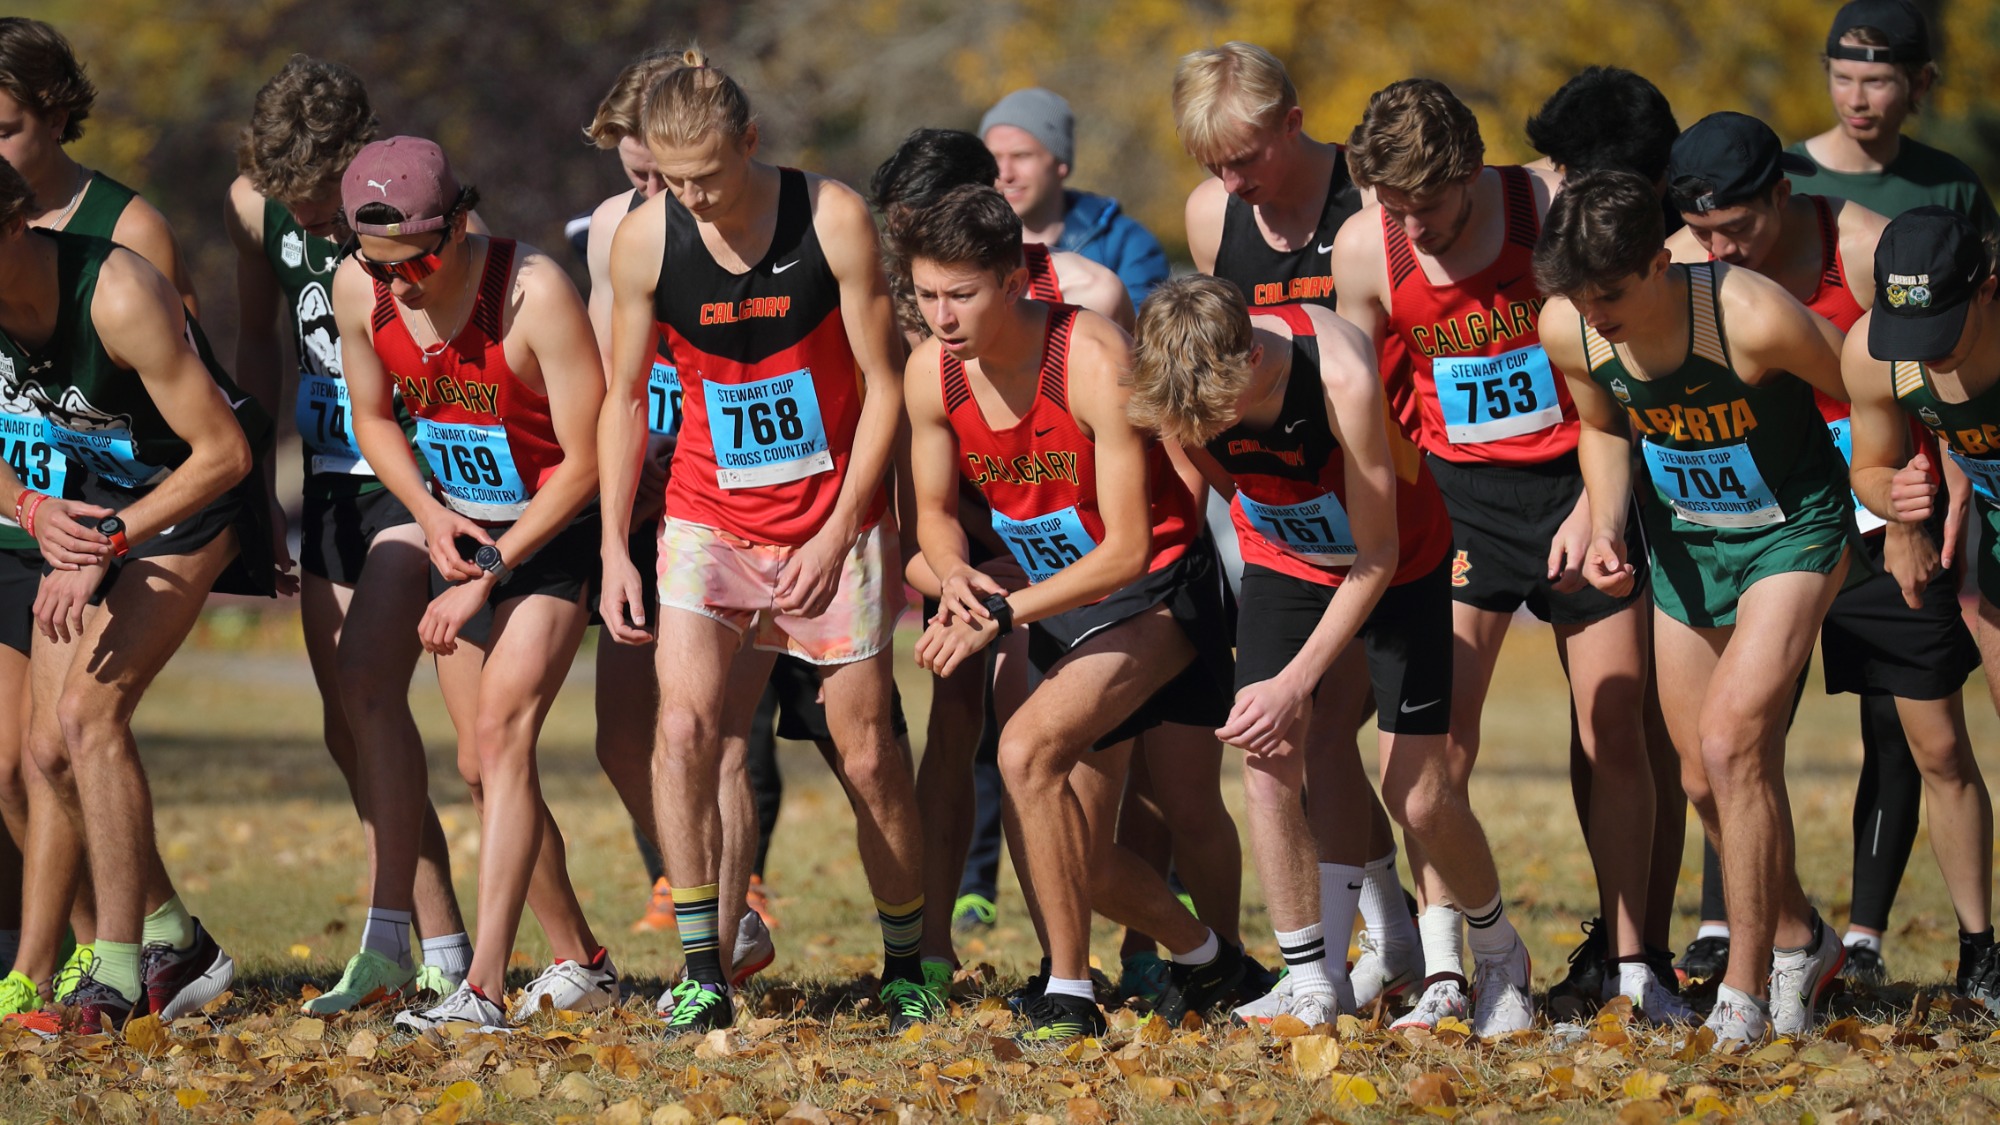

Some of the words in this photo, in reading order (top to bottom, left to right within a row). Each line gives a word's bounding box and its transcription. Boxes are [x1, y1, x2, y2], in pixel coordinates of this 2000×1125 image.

[1254, 276, 1334, 305] CALGARY
[700, 296, 790, 325] CALGARY
[1451, 360, 1503, 378] STEWART
[1506, 352, 1529, 370] CUP
[717, 385, 769, 403] STEWART
[772, 378, 795, 396] CUP
[1455, 371, 1538, 424] 753
[0, 418, 31, 436] EWART
[310, 400, 352, 447] 74
[427, 424, 467, 441] STEWART
[468, 429, 490, 442] CUP
[722, 397, 804, 450] 768
[1618, 398, 1759, 442] LBERTA
[51, 426, 88, 447] STEWART
[91, 436, 112, 448] CUP
[57, 442, 134, 476] 731
[430, 443, 504, 487] 769
[725, 450, 762, 466] CROSS
[763, 441, 816, 462] COUNTRY
[1657, 450, 1705, 465] STEWART
[1708, 452, 1731, 465] CUP
[967, 451, 1080, 486] CALGARY
[471, 488, 518, 502] COUNTRY
[1663, 466, 1748, 500] 704
[1251, 503, 1297, 517] STEWART
[1300, 503, 1322, 516] CUP
[1711, 498, 1763, 512] COUNTRY
[1001, 519, 1039, 536] STEWART
[1041, 517, 1062, 533] CUP
[1259, 516, 1336, 543] 767
[1009, 533, 1083, 571] 755
